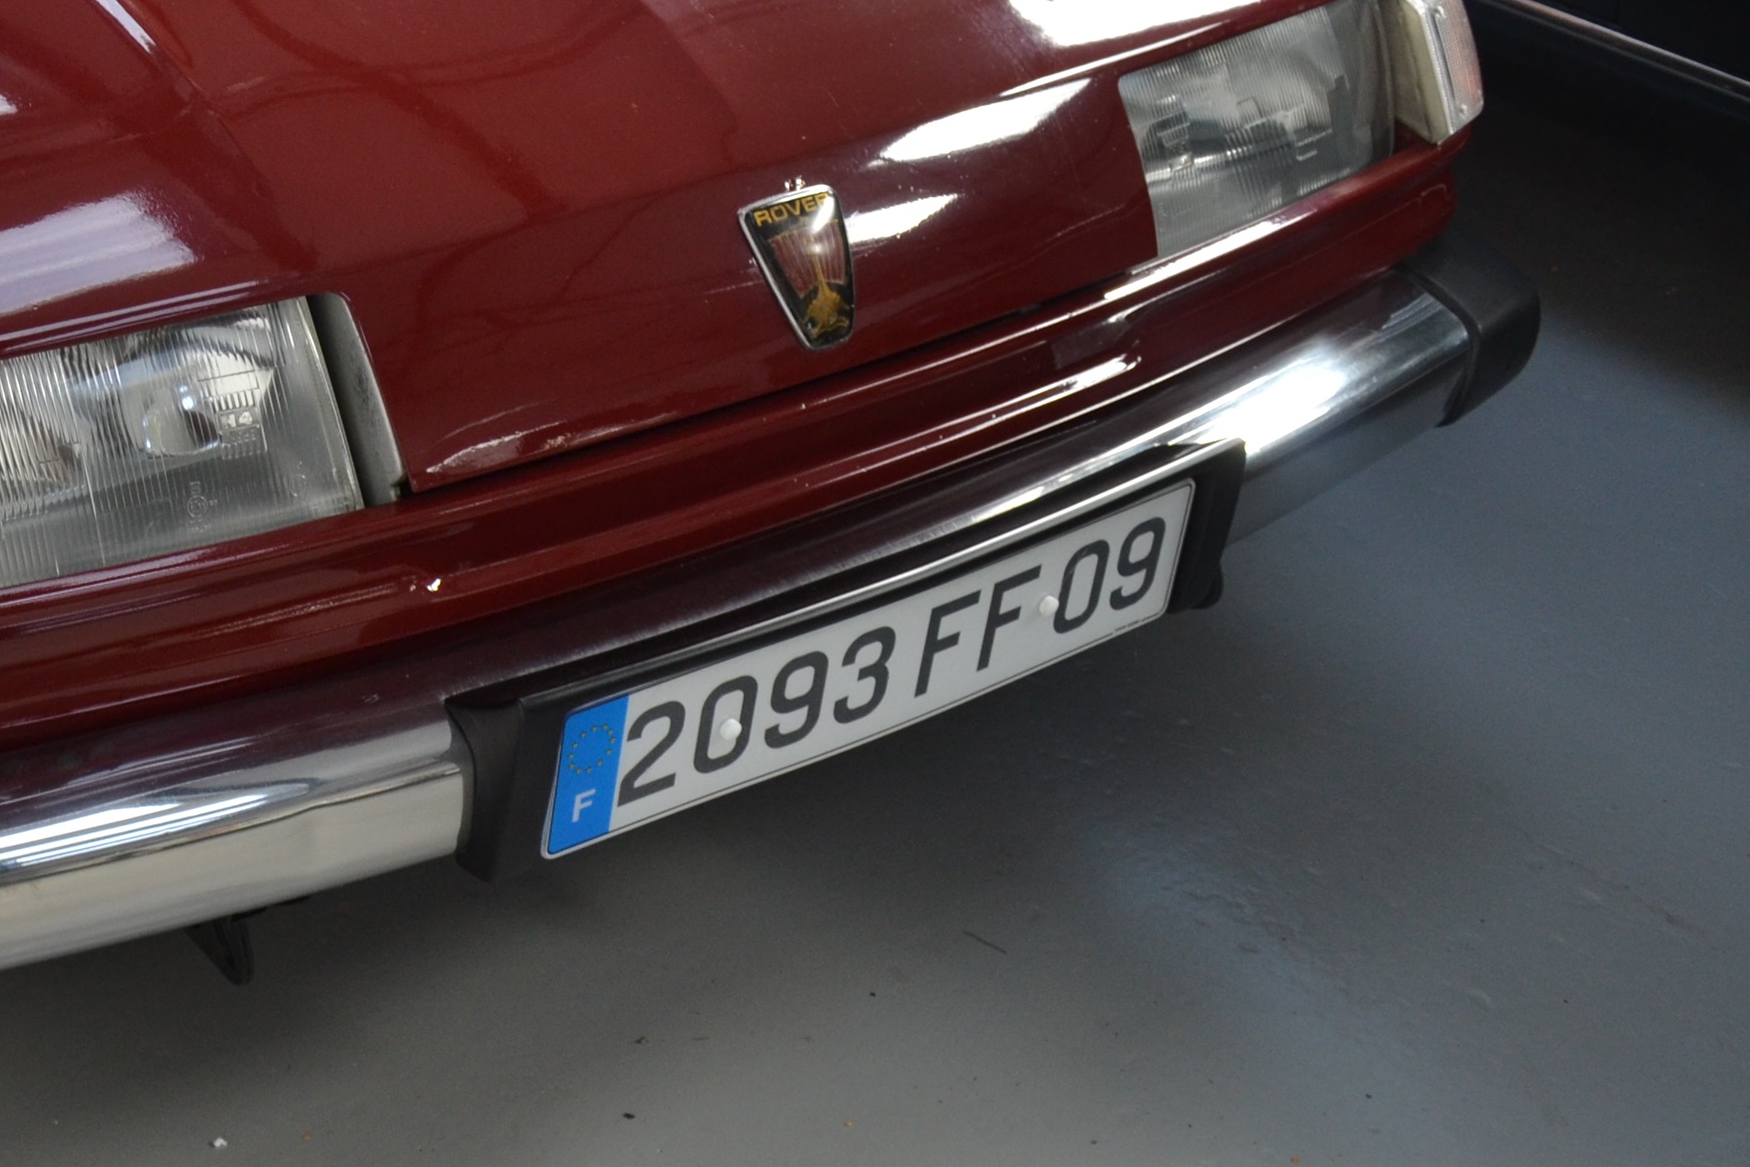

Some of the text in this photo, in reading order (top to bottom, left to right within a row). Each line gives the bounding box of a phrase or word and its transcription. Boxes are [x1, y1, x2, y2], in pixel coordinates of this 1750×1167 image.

[617, 517, 1167, 806] 2093 FF 09
[572, 788, 596, 823] F
